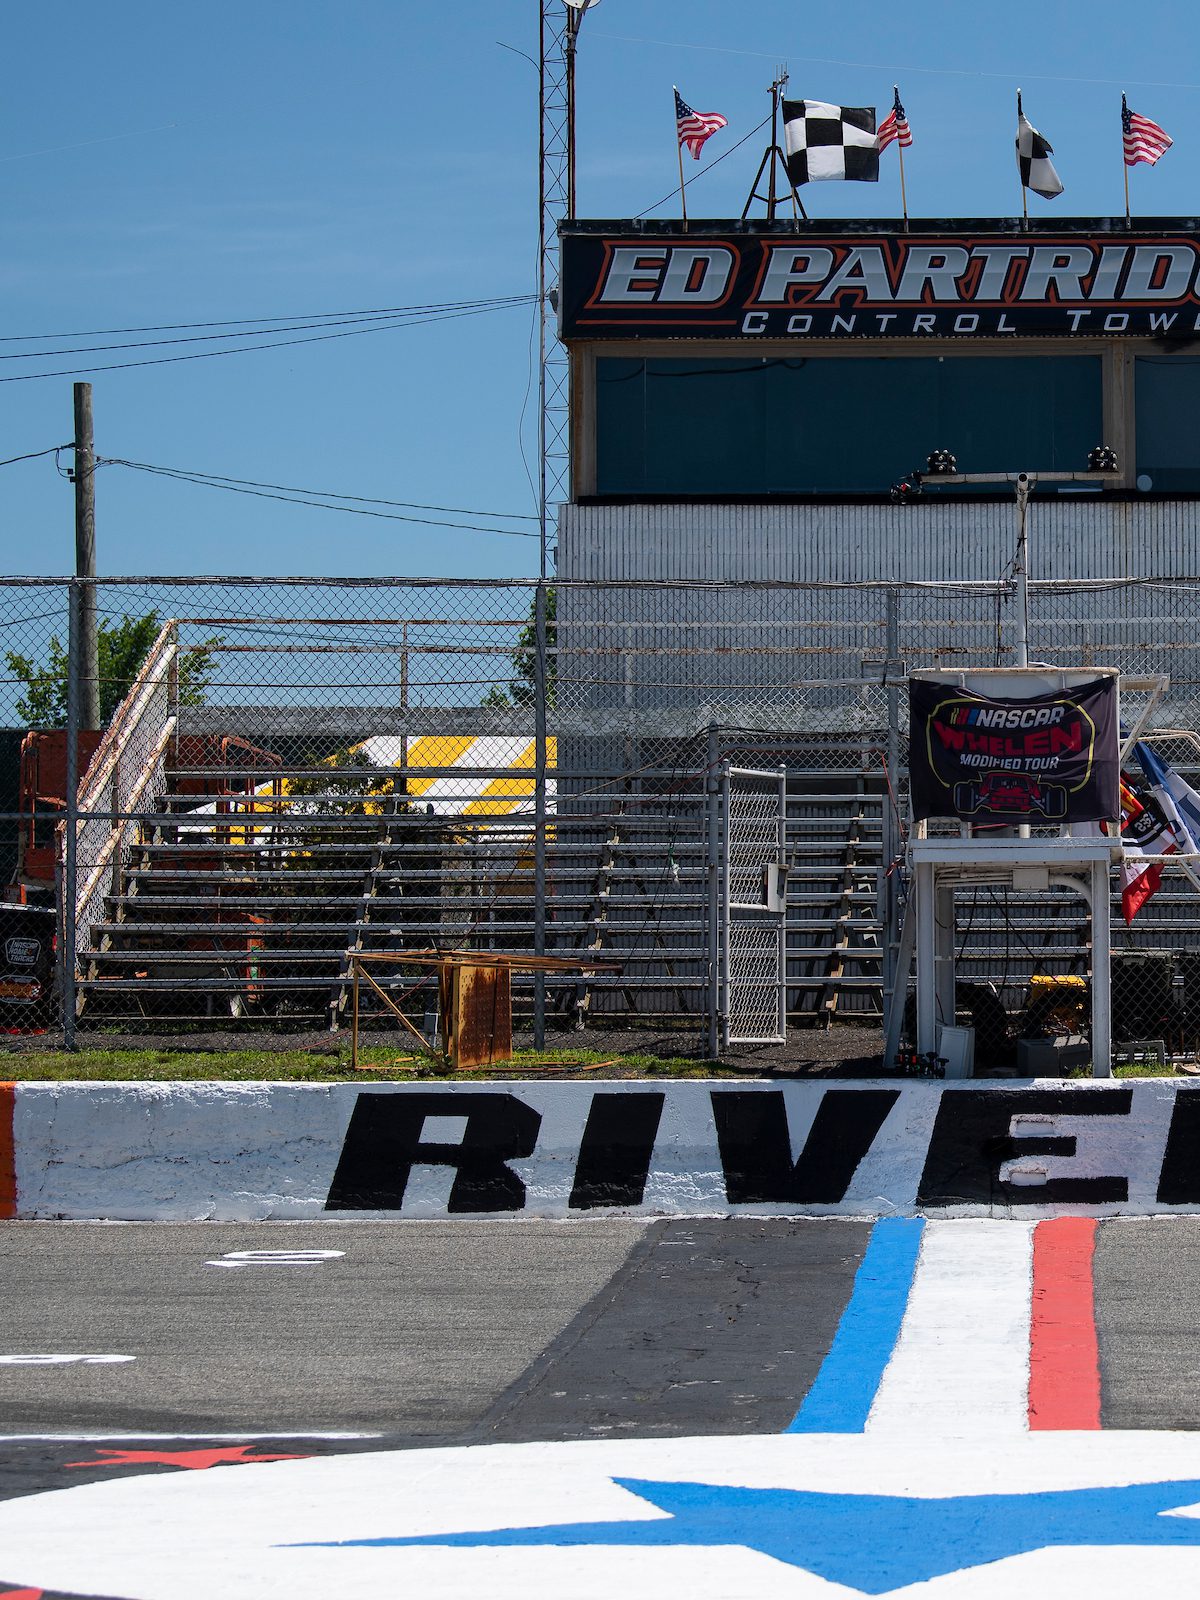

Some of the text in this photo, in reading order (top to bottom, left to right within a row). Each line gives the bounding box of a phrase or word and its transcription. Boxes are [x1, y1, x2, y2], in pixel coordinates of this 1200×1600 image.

[600, 247, 734, 302] ED
[741, 310, 1018, 334] CONTROL
[975, 706, 1066, 729] NASCAR
[933, 720, 1082, 757] WHELEN
[960, 753, 1060, 770] MODIFIED TOUR
